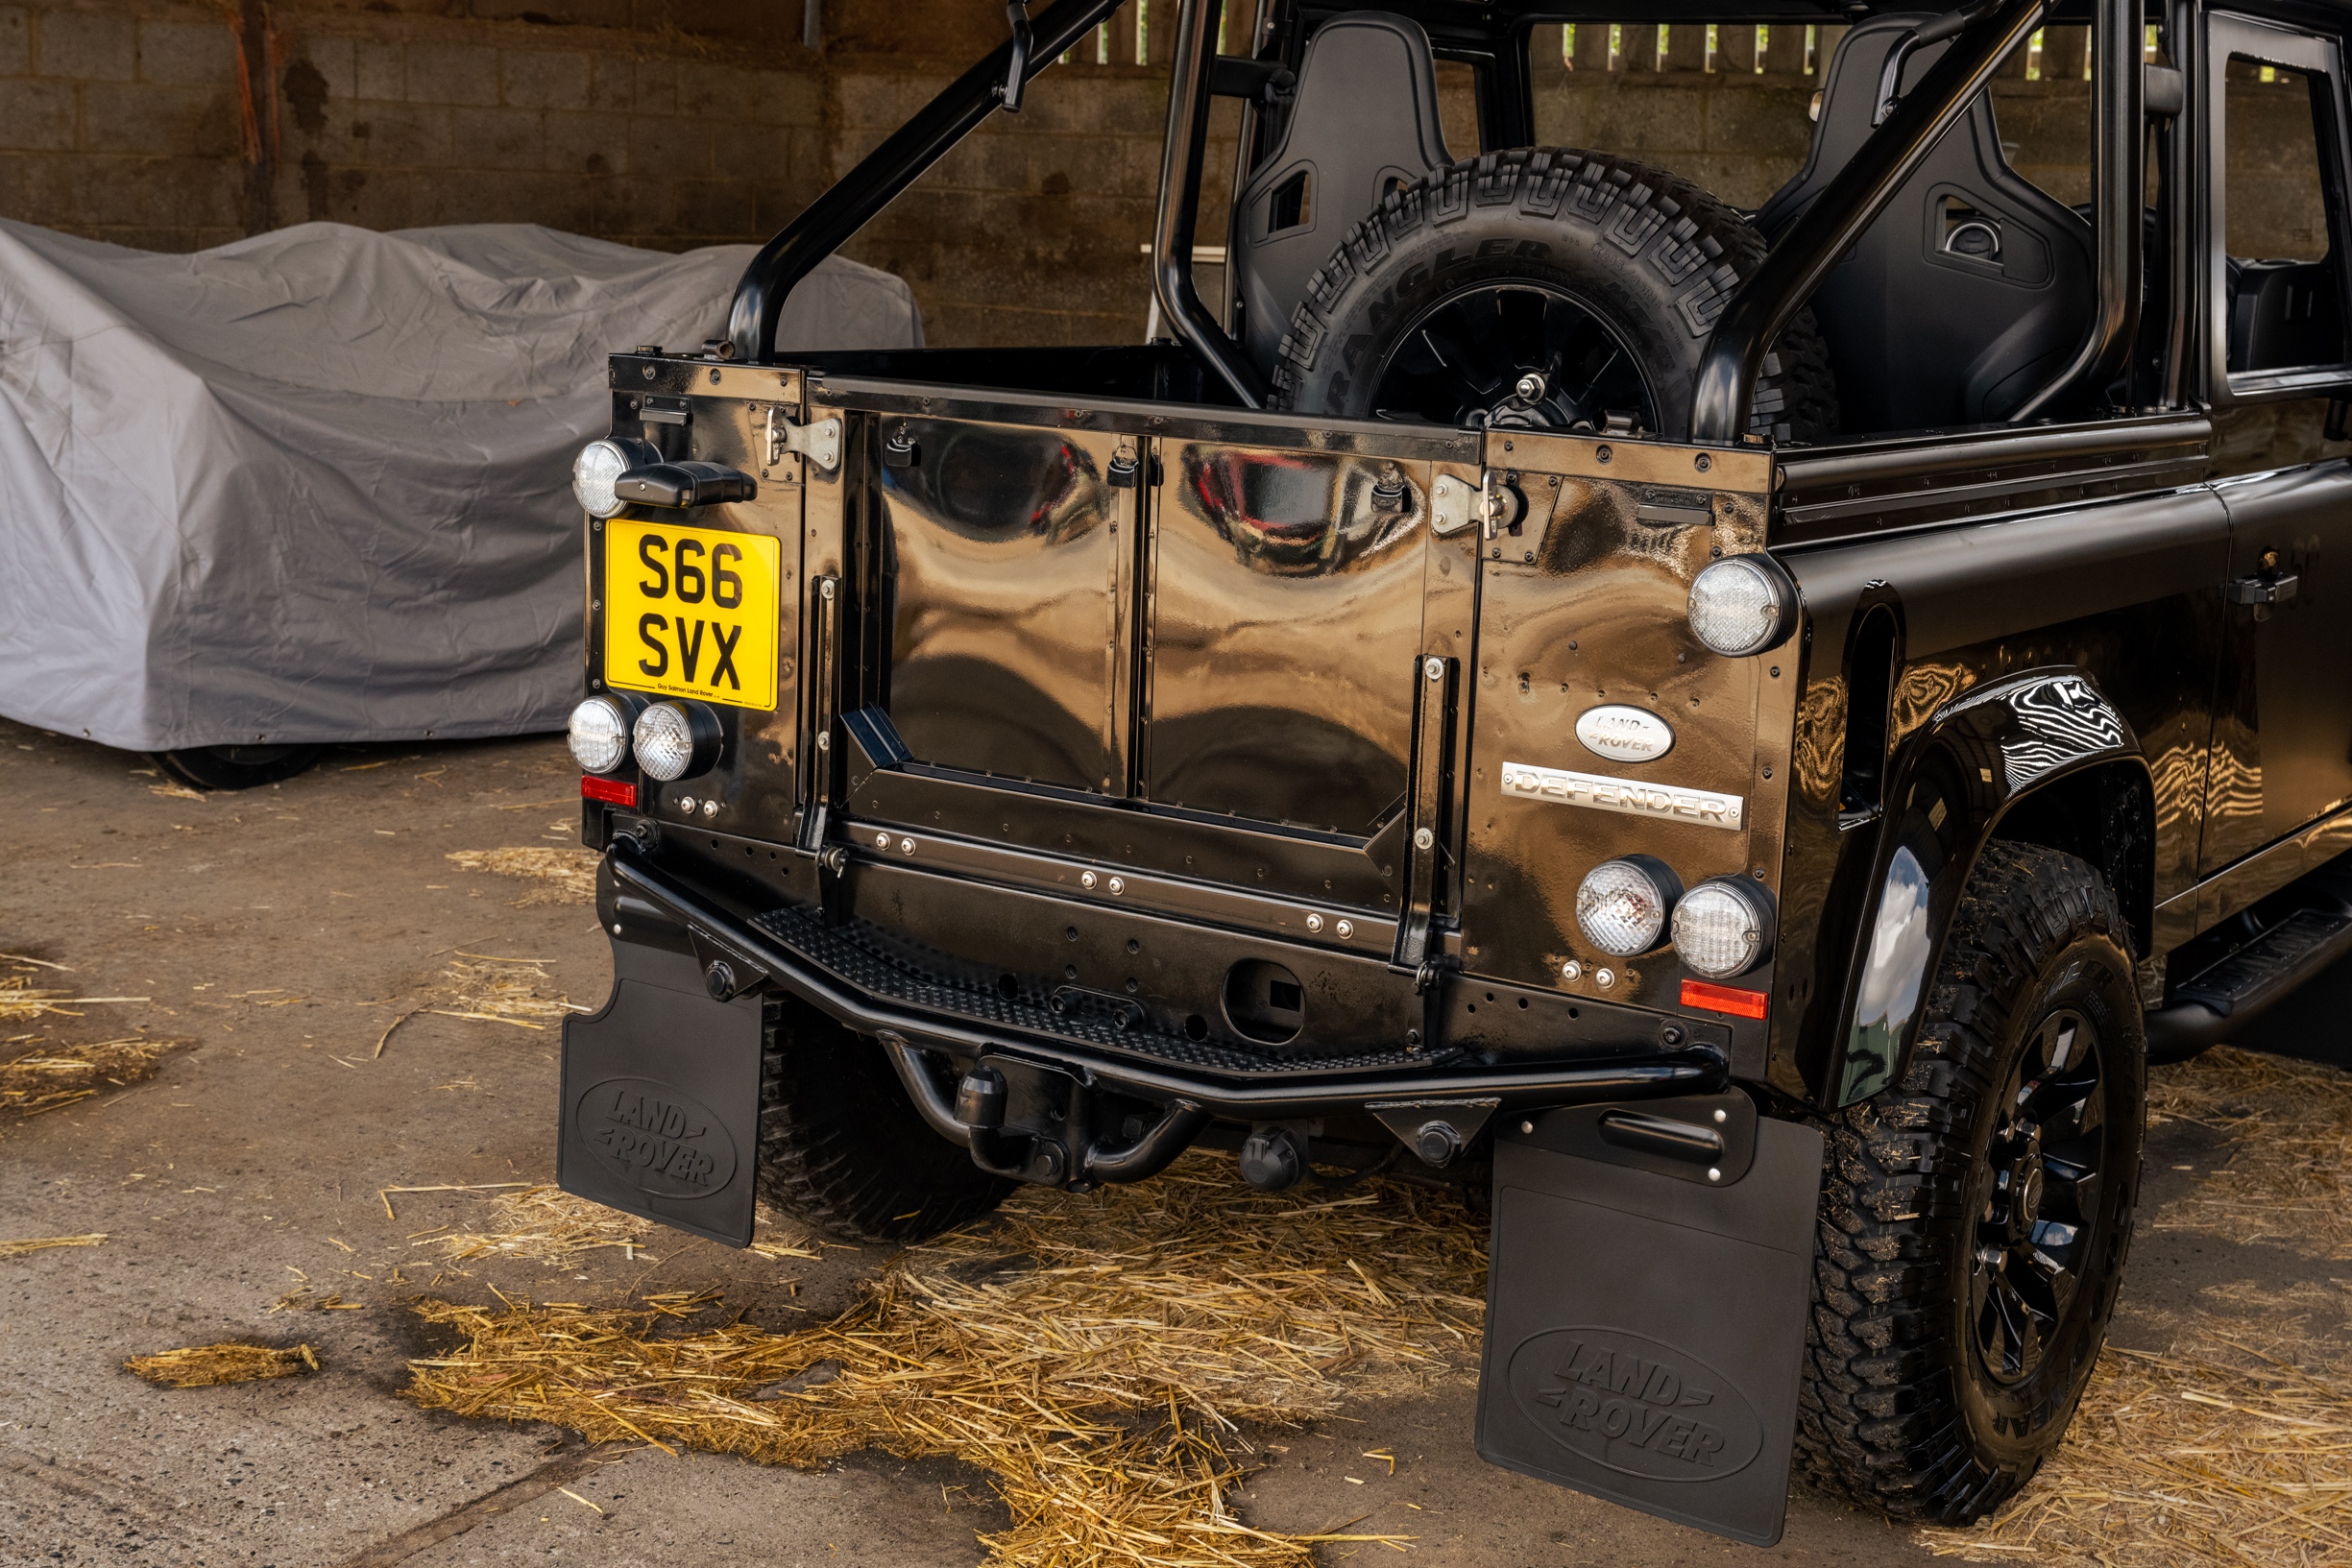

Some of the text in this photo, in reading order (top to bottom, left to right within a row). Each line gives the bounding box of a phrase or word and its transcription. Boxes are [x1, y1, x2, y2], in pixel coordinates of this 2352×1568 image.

[1323, 237, 1553, 416] RANGLER
[639, 533, 742, 610] S66
[639, 613, 742, 690] SVX
[668, 685, 686, 693] Salmon
[1595, 715, 1641, 734] LAND
[1598, 731, 1655, 752] ROVER
[1515, 770, 1728, 824] DEFENDER
[606, 1087, 686, 1140] LAND
[609, 1126, 715, 1187] ROVER
[1554, 1339, 1682, 1408] LAND
[1559, 1386, 1725, 1468] ROVER
